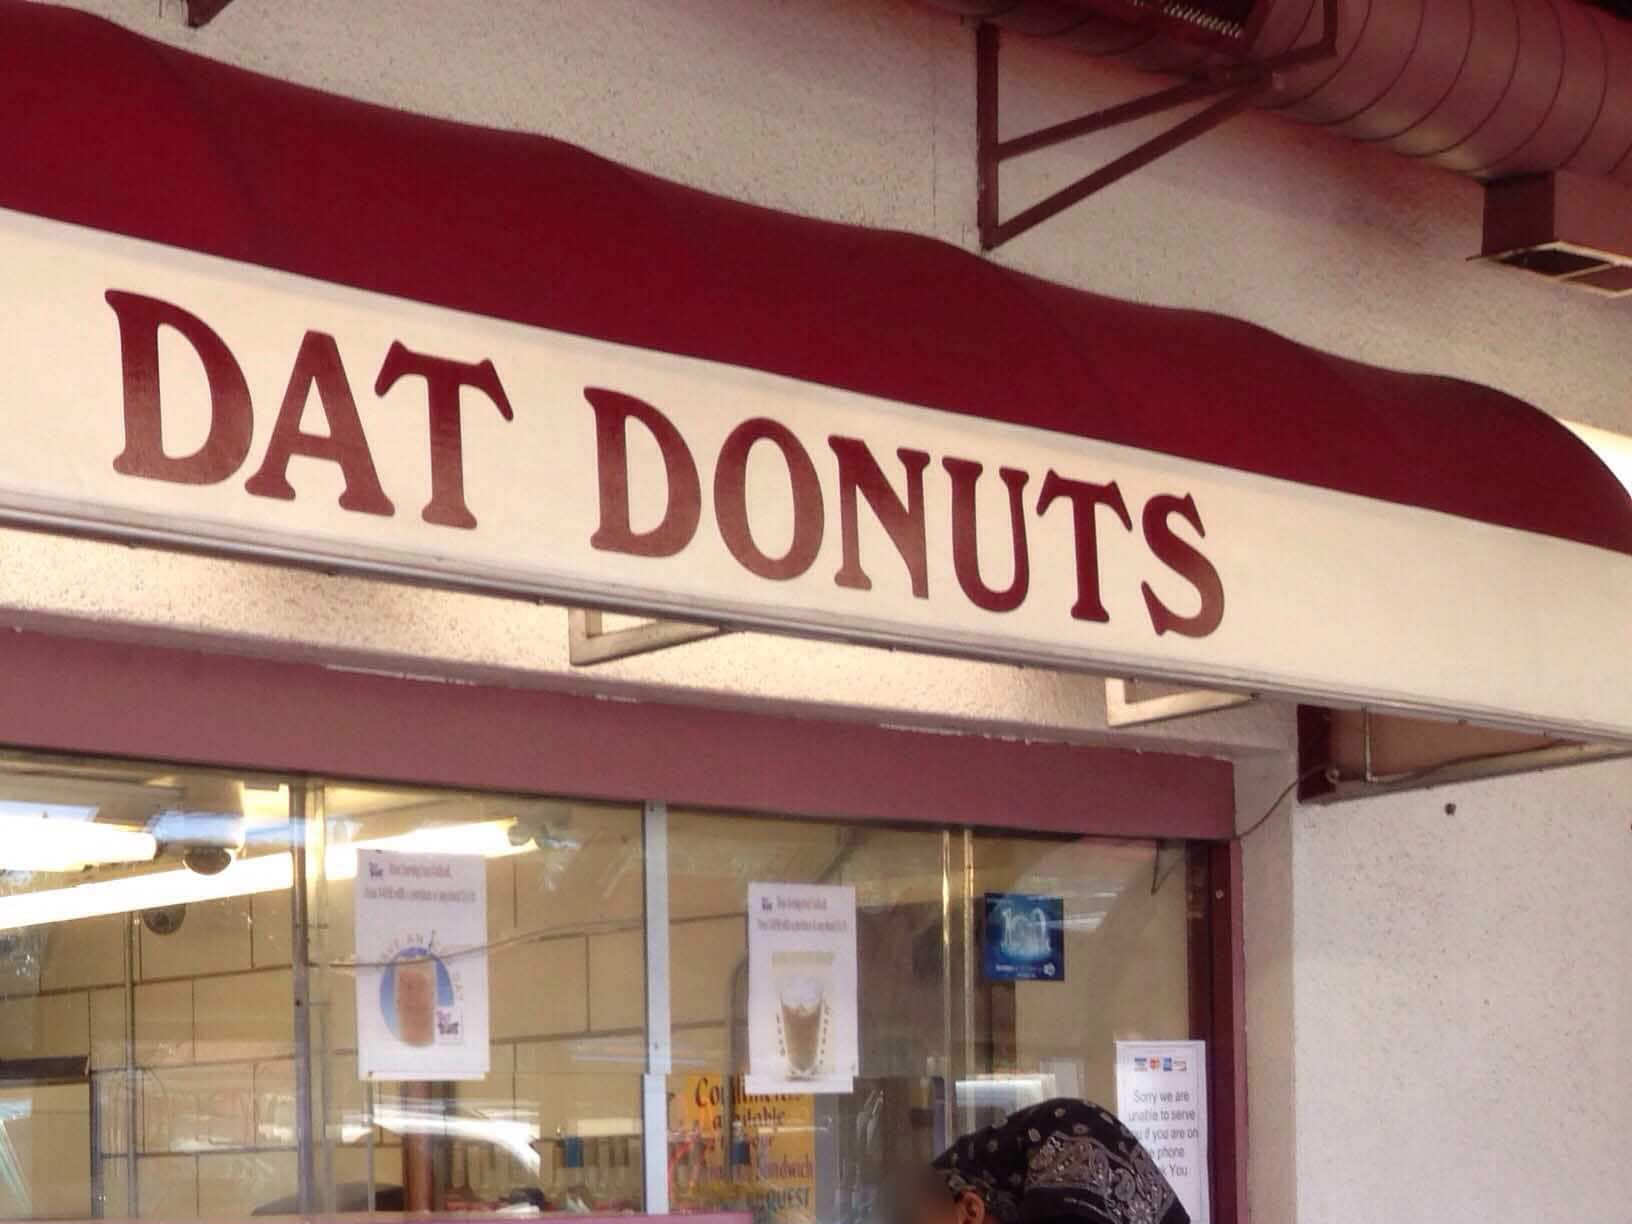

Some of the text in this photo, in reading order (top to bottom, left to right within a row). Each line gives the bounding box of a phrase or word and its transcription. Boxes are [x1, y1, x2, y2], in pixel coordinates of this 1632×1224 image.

[104, 288, 1225, 639] DAT DONUTS
[1134, 1089, 1190, 1104] Sorry we are
[1128, 1109, 1196, 1121] unable to serve
[1152, 1129, 1168, 1141] you
[1170, 1129, 1185, 1138] are
[1187, 1128, 1198, 1139] on
[1157, 1146, 1185, 1160] phone
[1169, 1166, 1188, 1177] You
